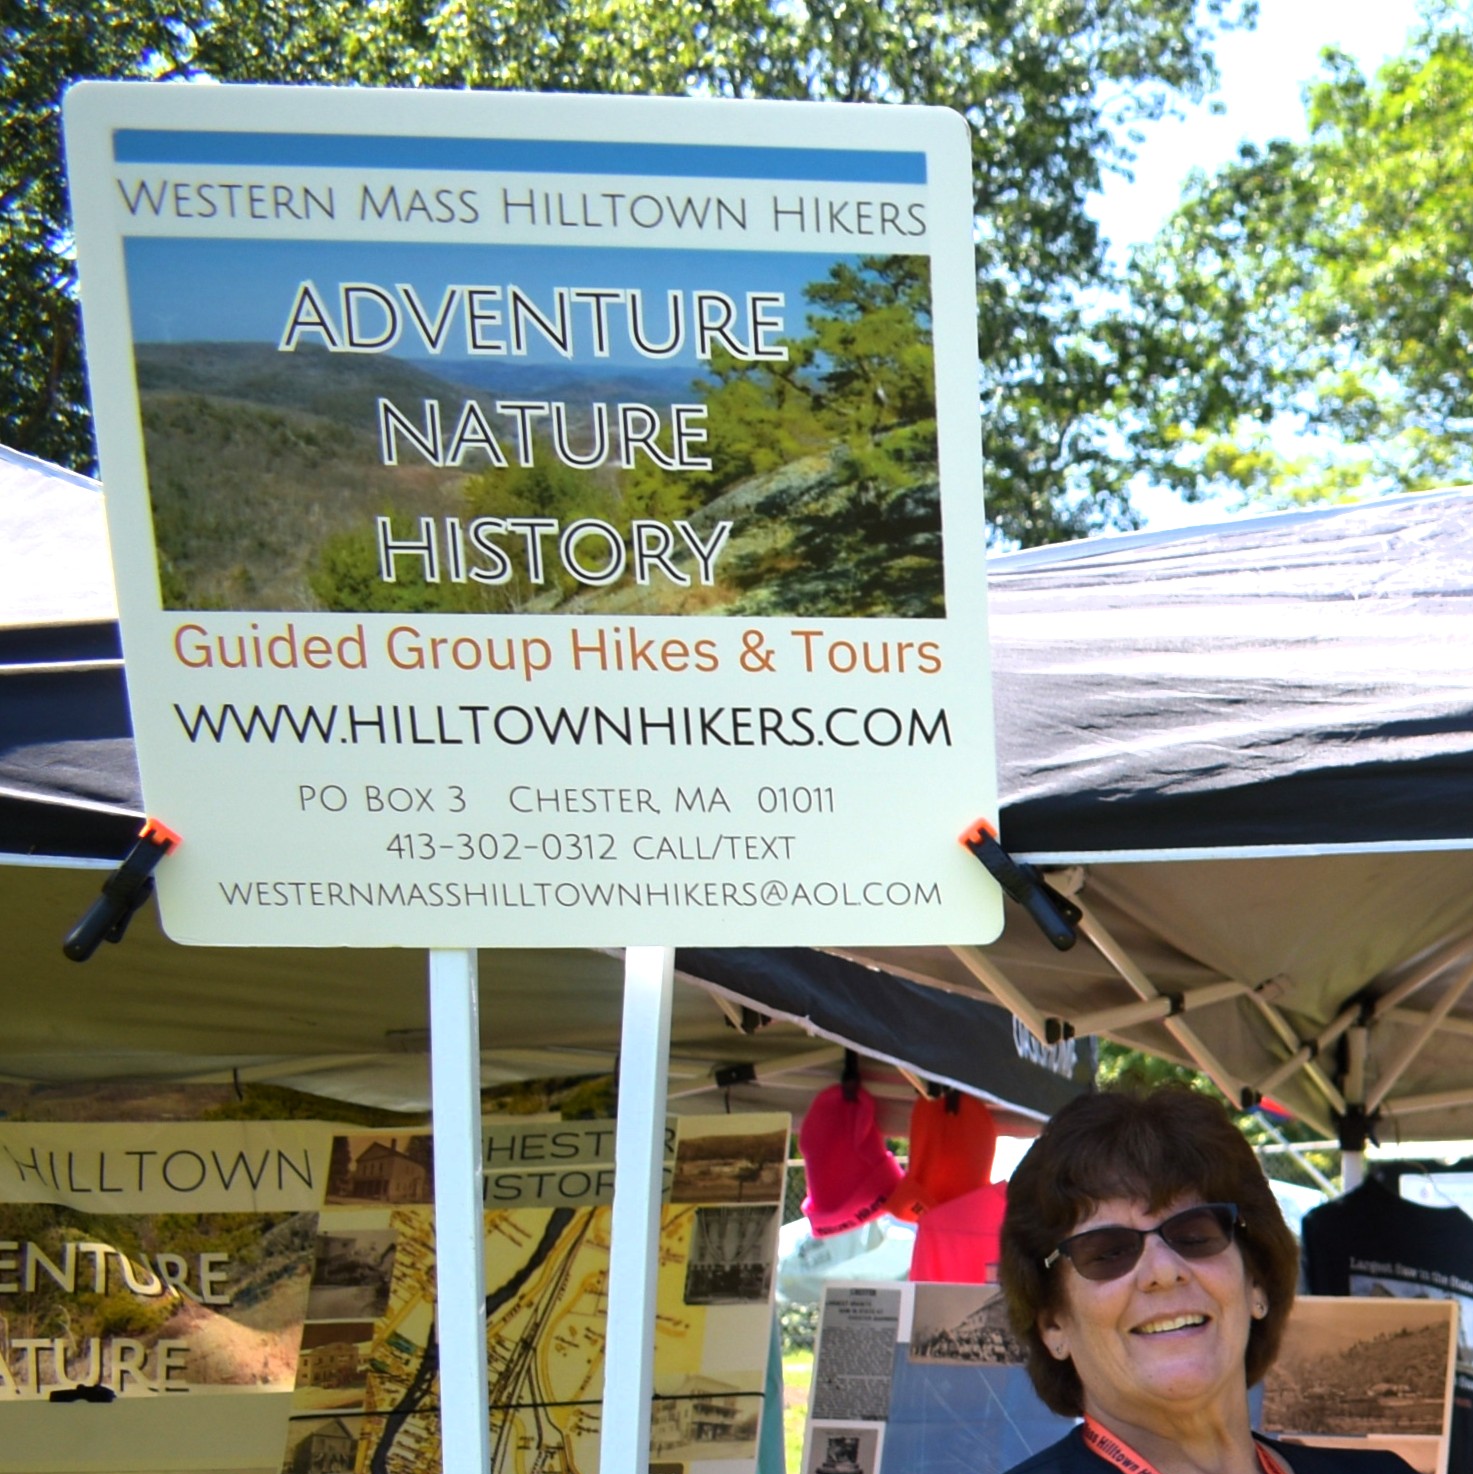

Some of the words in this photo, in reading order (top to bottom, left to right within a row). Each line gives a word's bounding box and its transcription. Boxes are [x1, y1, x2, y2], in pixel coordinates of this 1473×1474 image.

[118, 177, 335, 222] WESTERN
[361, 185, 480, 226] MASS
[502, 188, 748, 231] HILLTOWN
[774, 196, 928, 237] HIKERS
[279, 280, 788, 363] ADVENTURE
[377, 398, 713, 472] NATURE
[376, 516, 733, 587] HISTORY
[173, 621, 367, 672] Guided
[386, 624, 550, 682] Group
[572, 627, 719, 675] Hikes
[739, 628, 776, 675] &
[794, 629, 943, 677] Tours
[173, 701, 953, 750] WWW.HILLTOWNHIKERS.COM
[299, 784, 348, 813] PO
[364, 785, 442, 814] BOX
[449, 785, 467, 815] 3
[675, 786, 730, 815] MA
[757, 786, 833, 815] 01011
[386, 833, 617, 862] 413-302-0312
[632, 833, 796, 863] CALL/TEXT
[219, 880, 942, 908] WESTERNMASSHILLTOWNHIKERS@AOL.COM
[3, 1145, 313, 1192] HILLTOWN
[1098, 1436, 1139, 1471] Hilltown
